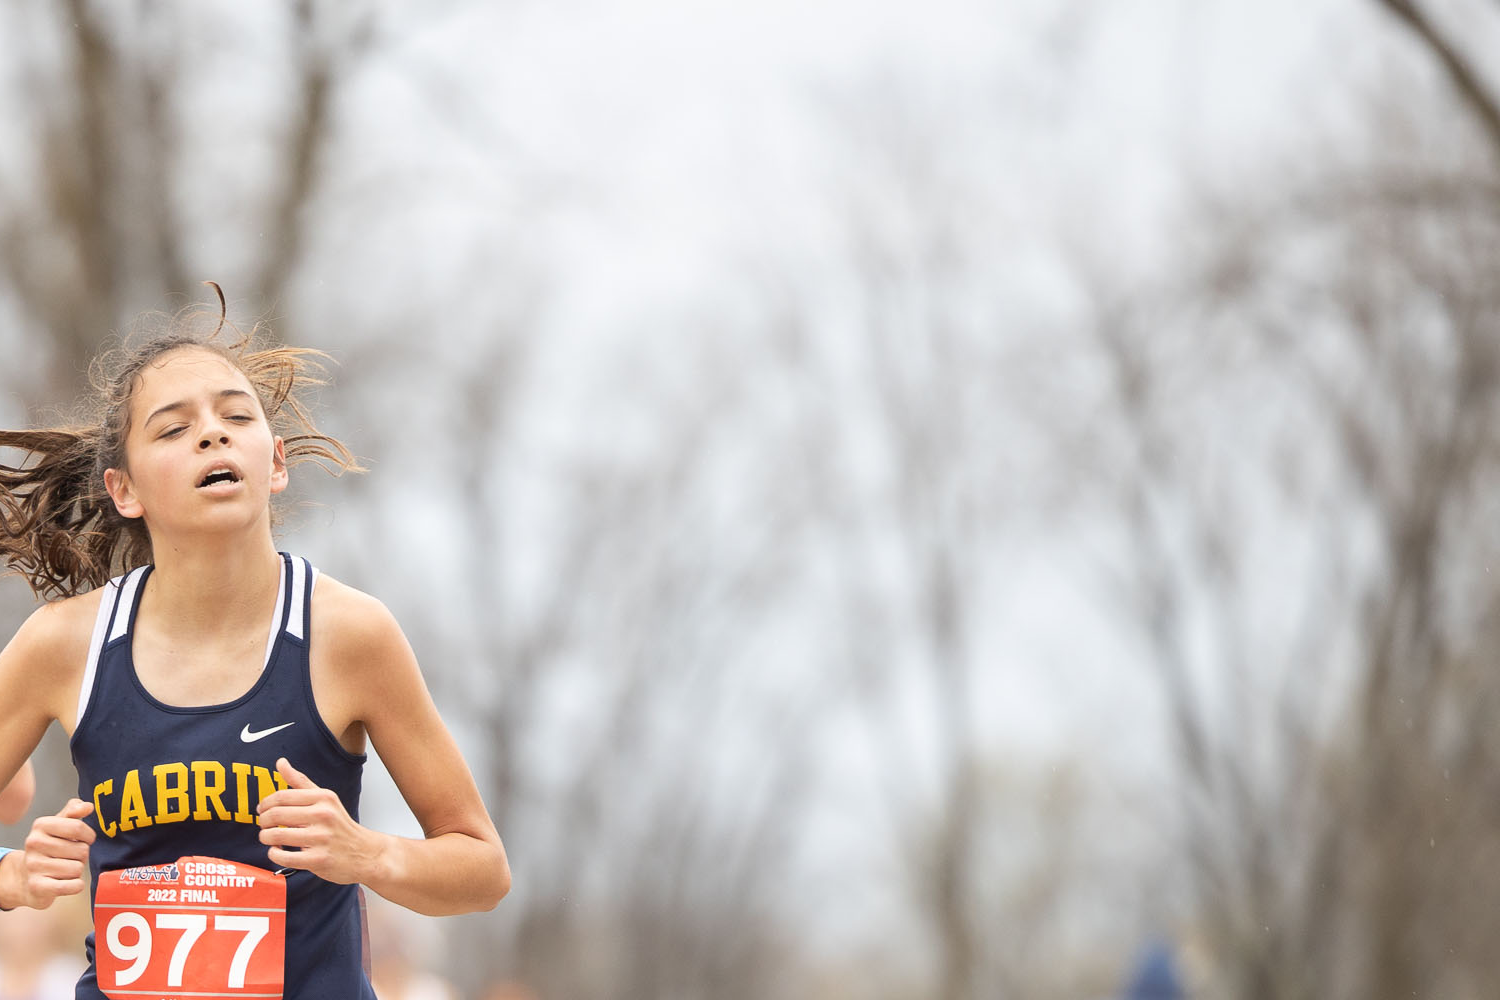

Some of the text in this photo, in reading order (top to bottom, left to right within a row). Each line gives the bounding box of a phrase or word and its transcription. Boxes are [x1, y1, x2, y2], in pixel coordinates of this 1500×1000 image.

[184, 862, 237, 875] CROSS
[184, 875, 256, 888] COUNTRY
[147, 889, 220, 903] 2022 FINAL
[105, 911, 270, 989] 977
